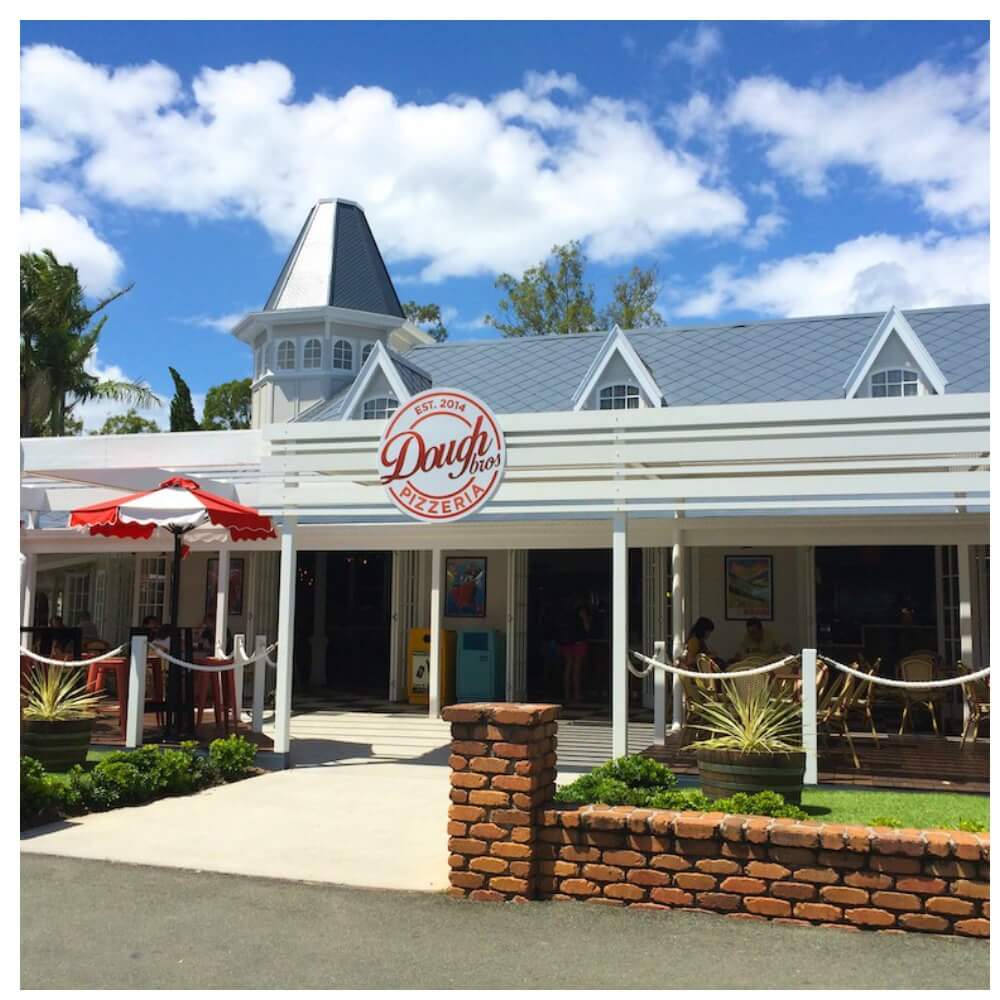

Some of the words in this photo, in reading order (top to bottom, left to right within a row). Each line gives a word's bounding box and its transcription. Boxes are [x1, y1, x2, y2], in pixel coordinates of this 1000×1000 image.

[414, 399, 437, 415] EST.
[439, 399, 467, 412] 2014
[380, 415, 494, 485] Dough
[468, 453, 501, 475] bros
[399, 484, 484, 514] PIZZERIA
